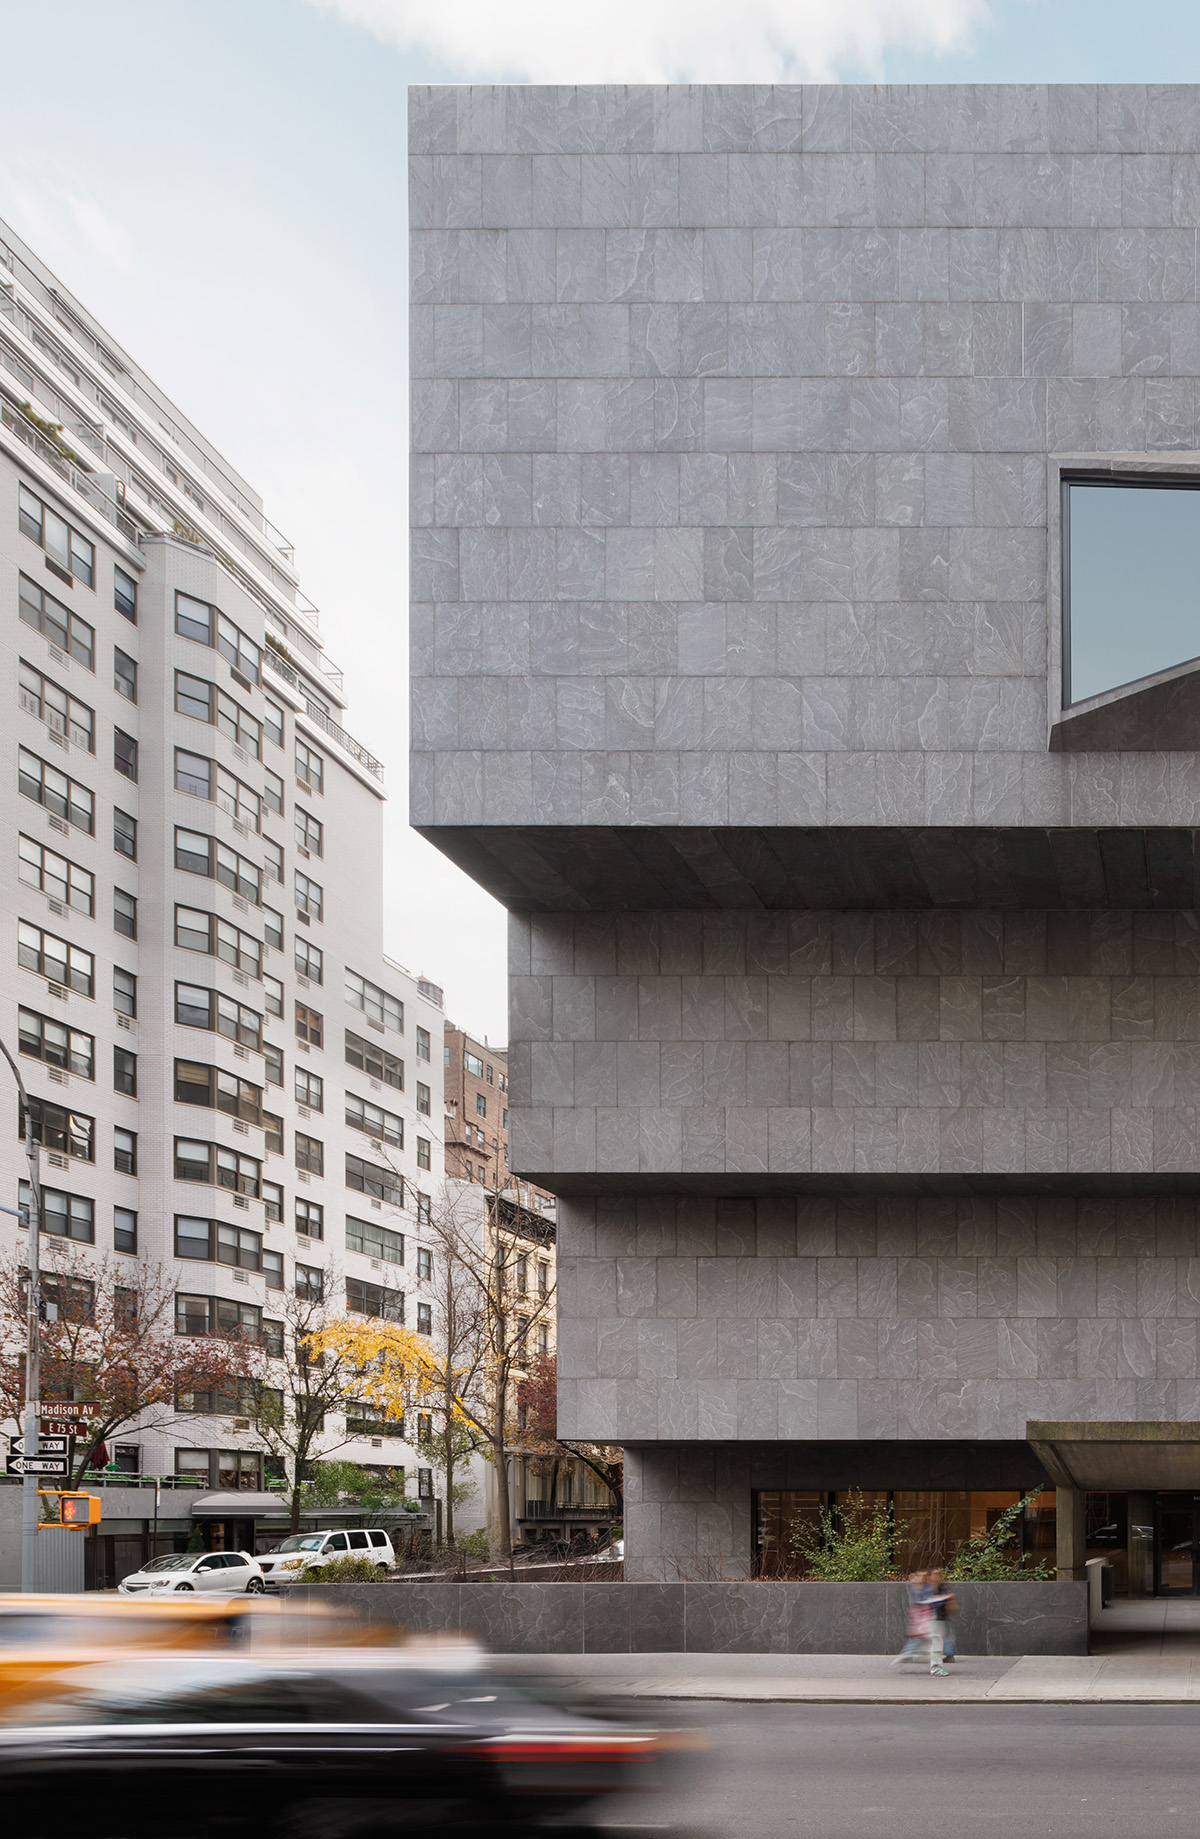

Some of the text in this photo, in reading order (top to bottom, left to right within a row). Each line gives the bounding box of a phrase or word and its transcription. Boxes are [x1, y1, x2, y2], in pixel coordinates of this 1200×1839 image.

[41, 1404, 94, 1415] Madison Av
[49, 1422, 78, 1435] E 75 St
[15, 1461, 60, 1470] ONE WAY
